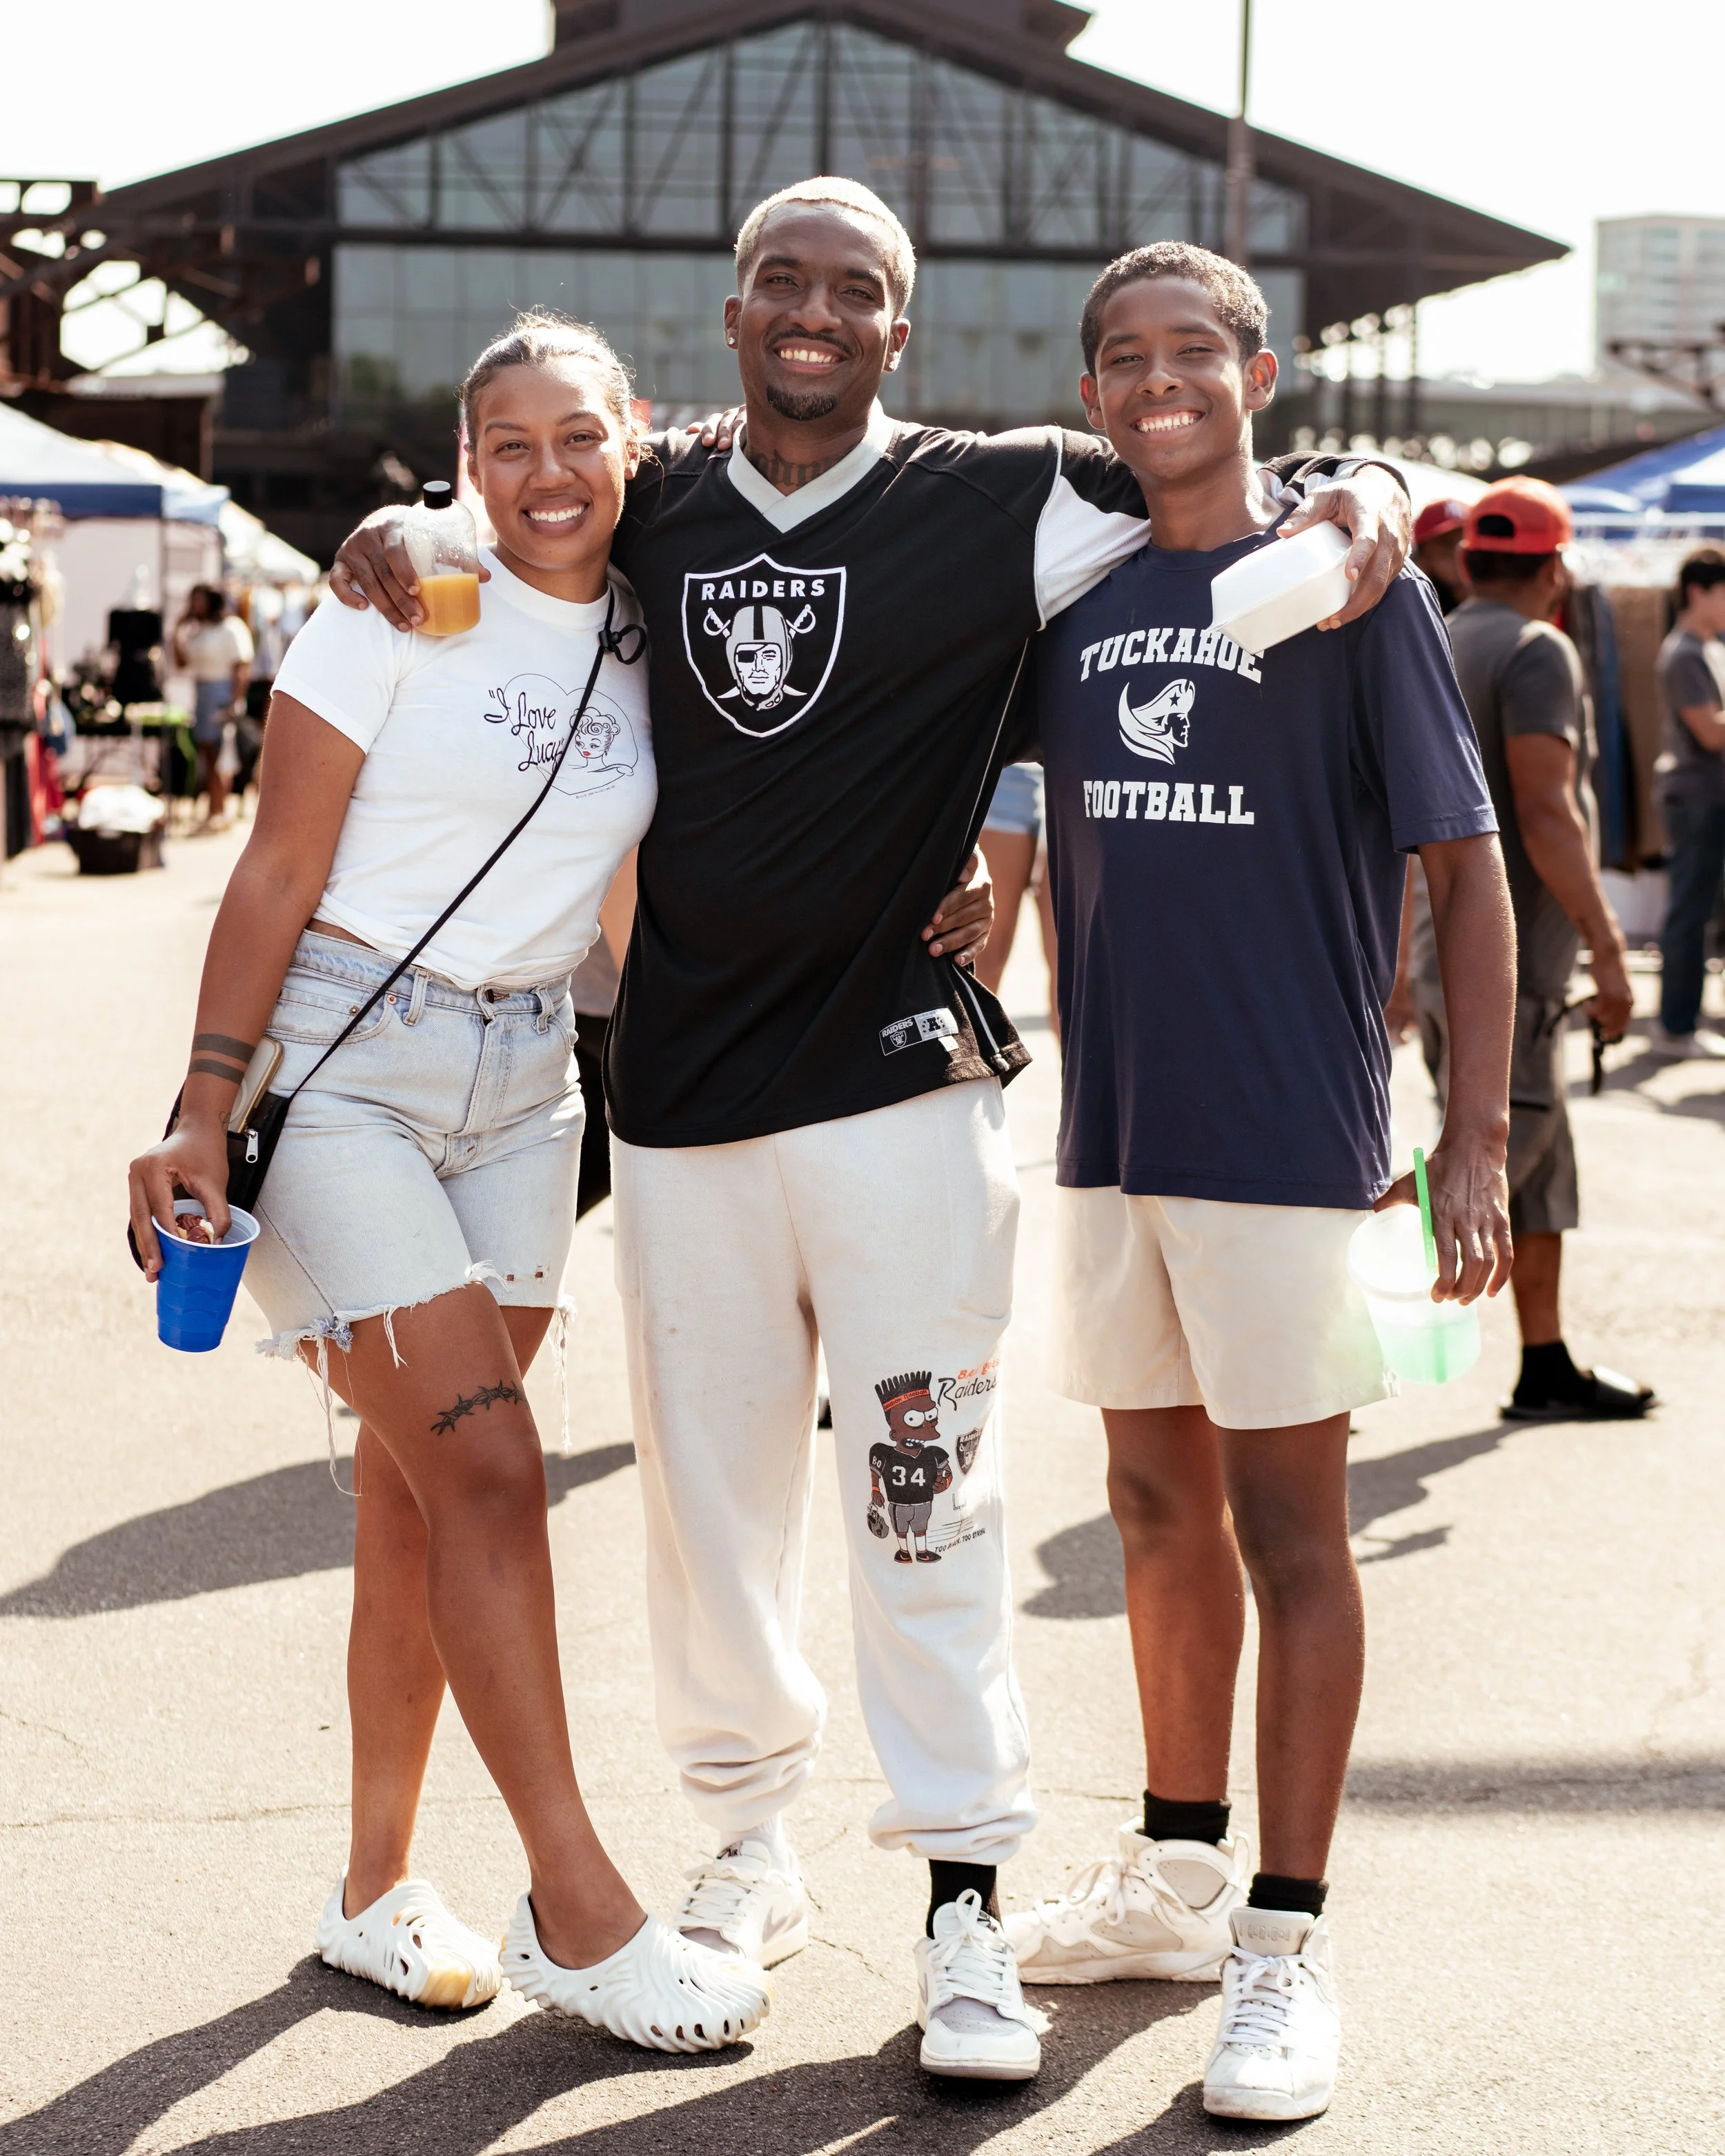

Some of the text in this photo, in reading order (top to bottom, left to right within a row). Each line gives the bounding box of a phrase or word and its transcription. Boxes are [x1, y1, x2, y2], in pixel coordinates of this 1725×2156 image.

[701, 579, 825, 601] RAIDERS
[1080, 627, 1265, 684] TUCKAHOE
[511, 691, 556, 736] Love
[1083, 780, 1254, 825] FOOTBALL
[882, 1019, 914, 1038] RAIDERS
[938, 1374, 997, 1412] Raiders
[892, 1465, 926, 1487] 34
[934, 1545, 946, 1553] TOO
[962, 1534, 972, 1542] TOO
